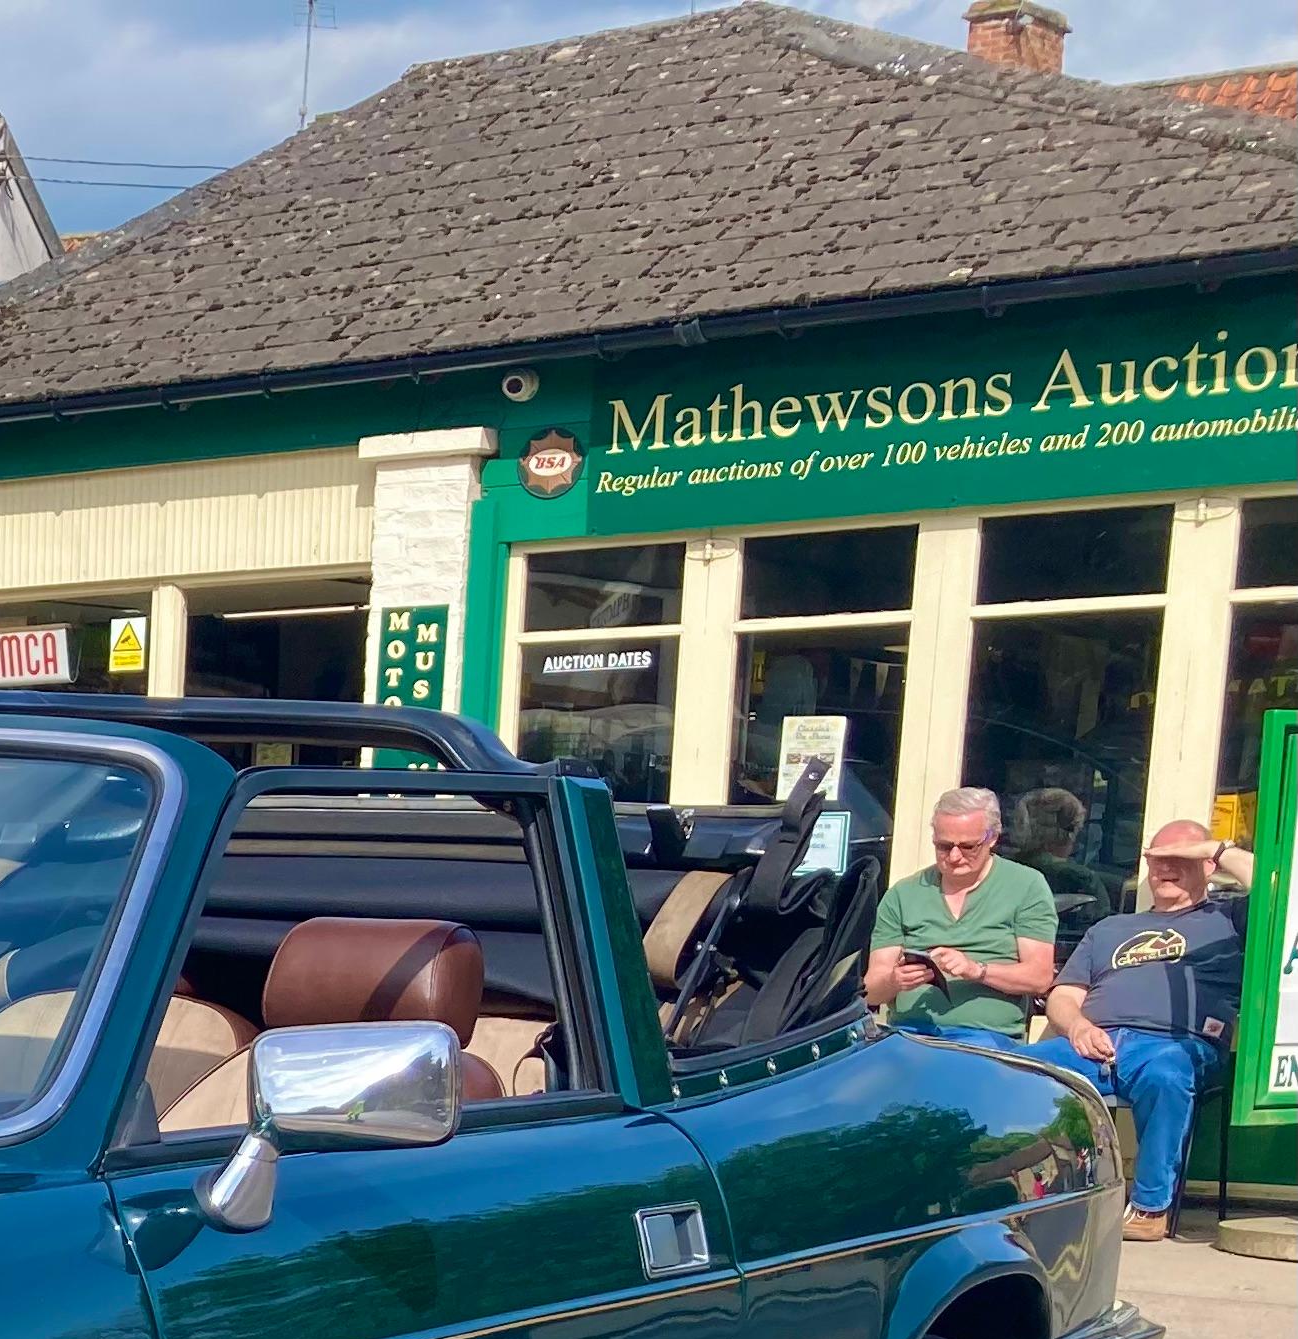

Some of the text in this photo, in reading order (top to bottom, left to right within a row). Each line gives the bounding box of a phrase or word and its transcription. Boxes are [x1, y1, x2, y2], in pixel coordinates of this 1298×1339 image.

[596, 406, 1298, 497] Regular auctions of over 100 vehicles and 200 automobili
[606, 372, 1012, 455] Mathewsons
[534, 456, 566, 469] BSA
[384, 612, 411, 706] MOTO
[413, 623, 439, 698] MUS
[543, 651, 652, 671] AUCTION DATES
